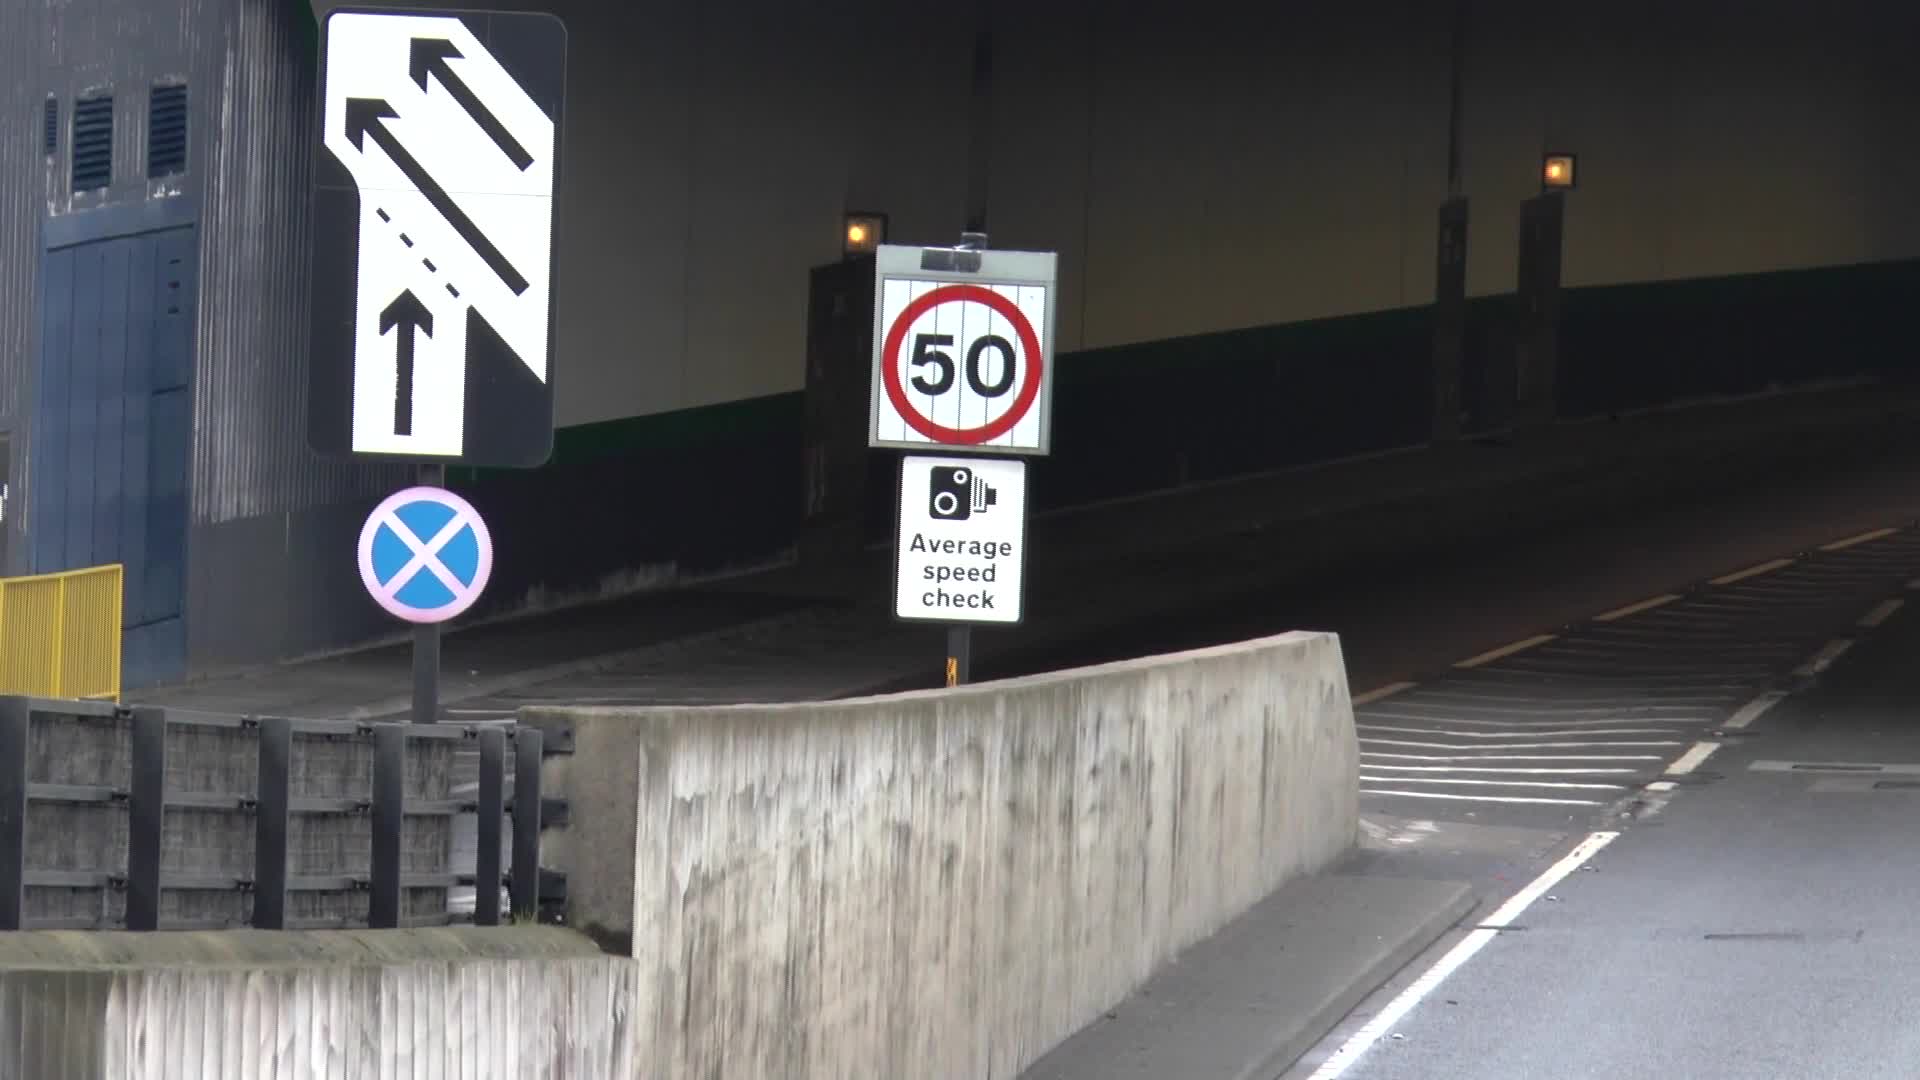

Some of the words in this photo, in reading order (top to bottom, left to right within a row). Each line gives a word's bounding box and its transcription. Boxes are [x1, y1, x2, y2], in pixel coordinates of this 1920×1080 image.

[911, 333, 1016, 398] 50
[910, 533, 1012, 560] Average
[923, 563, 996, 584] speed
[922, 588, 995, 609] check
